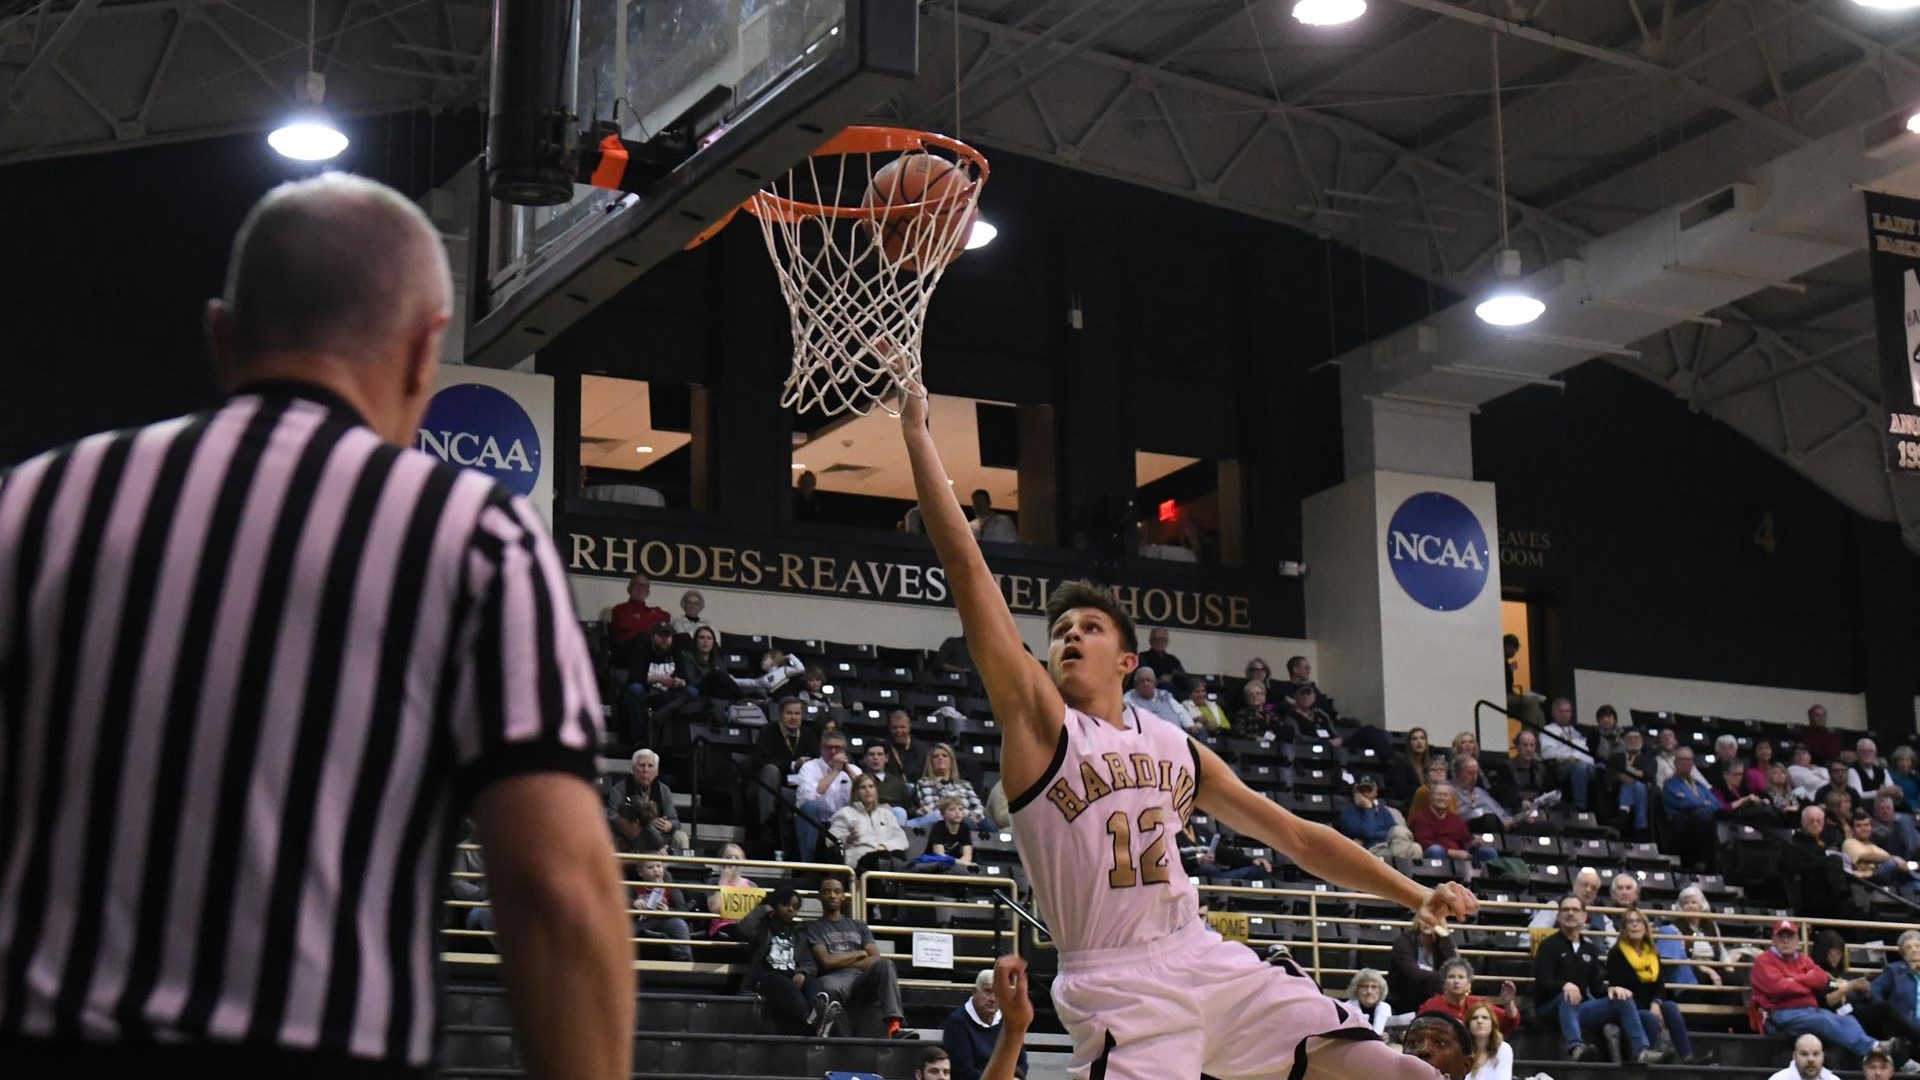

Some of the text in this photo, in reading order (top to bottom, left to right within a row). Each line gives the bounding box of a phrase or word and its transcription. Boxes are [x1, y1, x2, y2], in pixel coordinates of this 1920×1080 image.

[418, 428, 533, 472] NCAA
[1392, 530, 1484, 570] NCAA
[1499, 529, 1551, 549] EAVES
[1752, 512, 1776, 555] 4
[569, 533, 947, 601] RHODES-REAVES
[1500, 547, 1544, 567] OOM
[1106, 806, 1171, 889] 12
[1210, 917, 1246, 937] HOME
